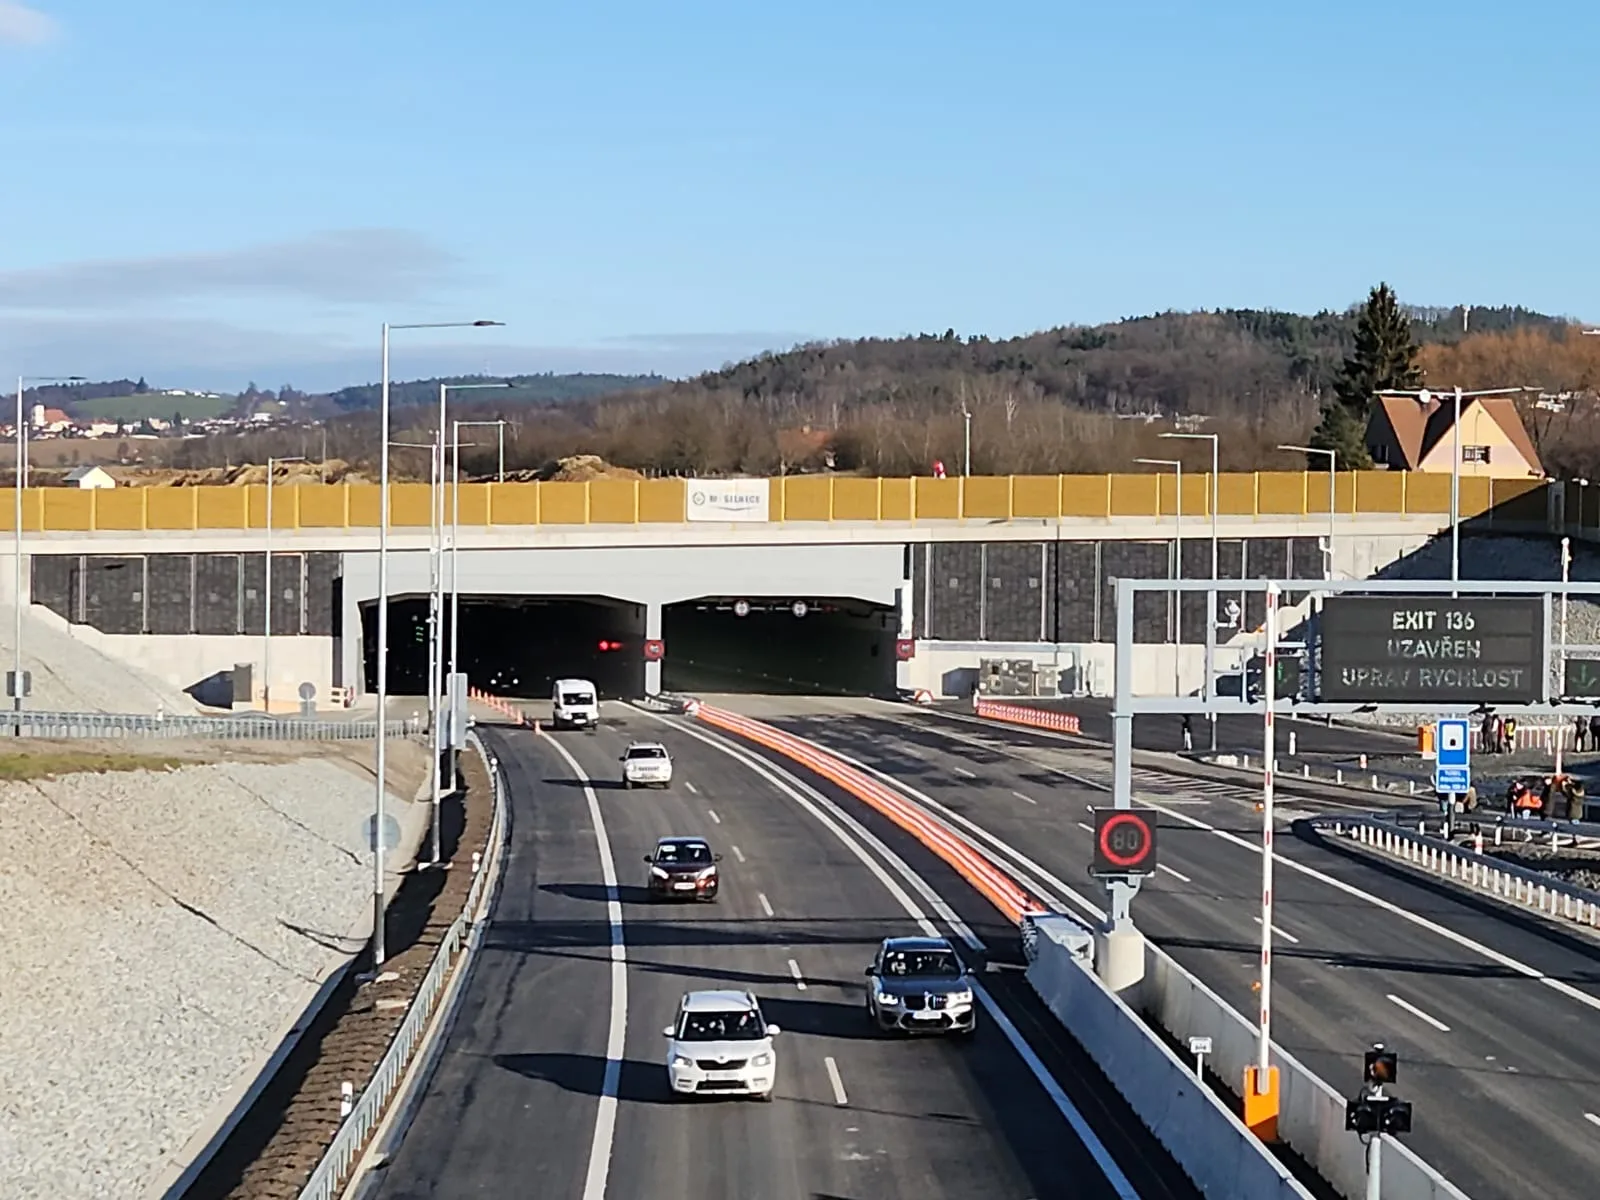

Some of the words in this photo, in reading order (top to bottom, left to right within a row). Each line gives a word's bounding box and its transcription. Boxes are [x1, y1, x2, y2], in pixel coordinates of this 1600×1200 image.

[1392, 610, 1437, 630] EXIT
[1445, 610, 1476, 630] 136
[1386, 635, 1481, 660] UZAVŘEN
[1341, 667, 1411, 688] UPRAV
[1418, 667, 1524, 688] RYCHLOST
[1112, 829, 1139, 850] 80
